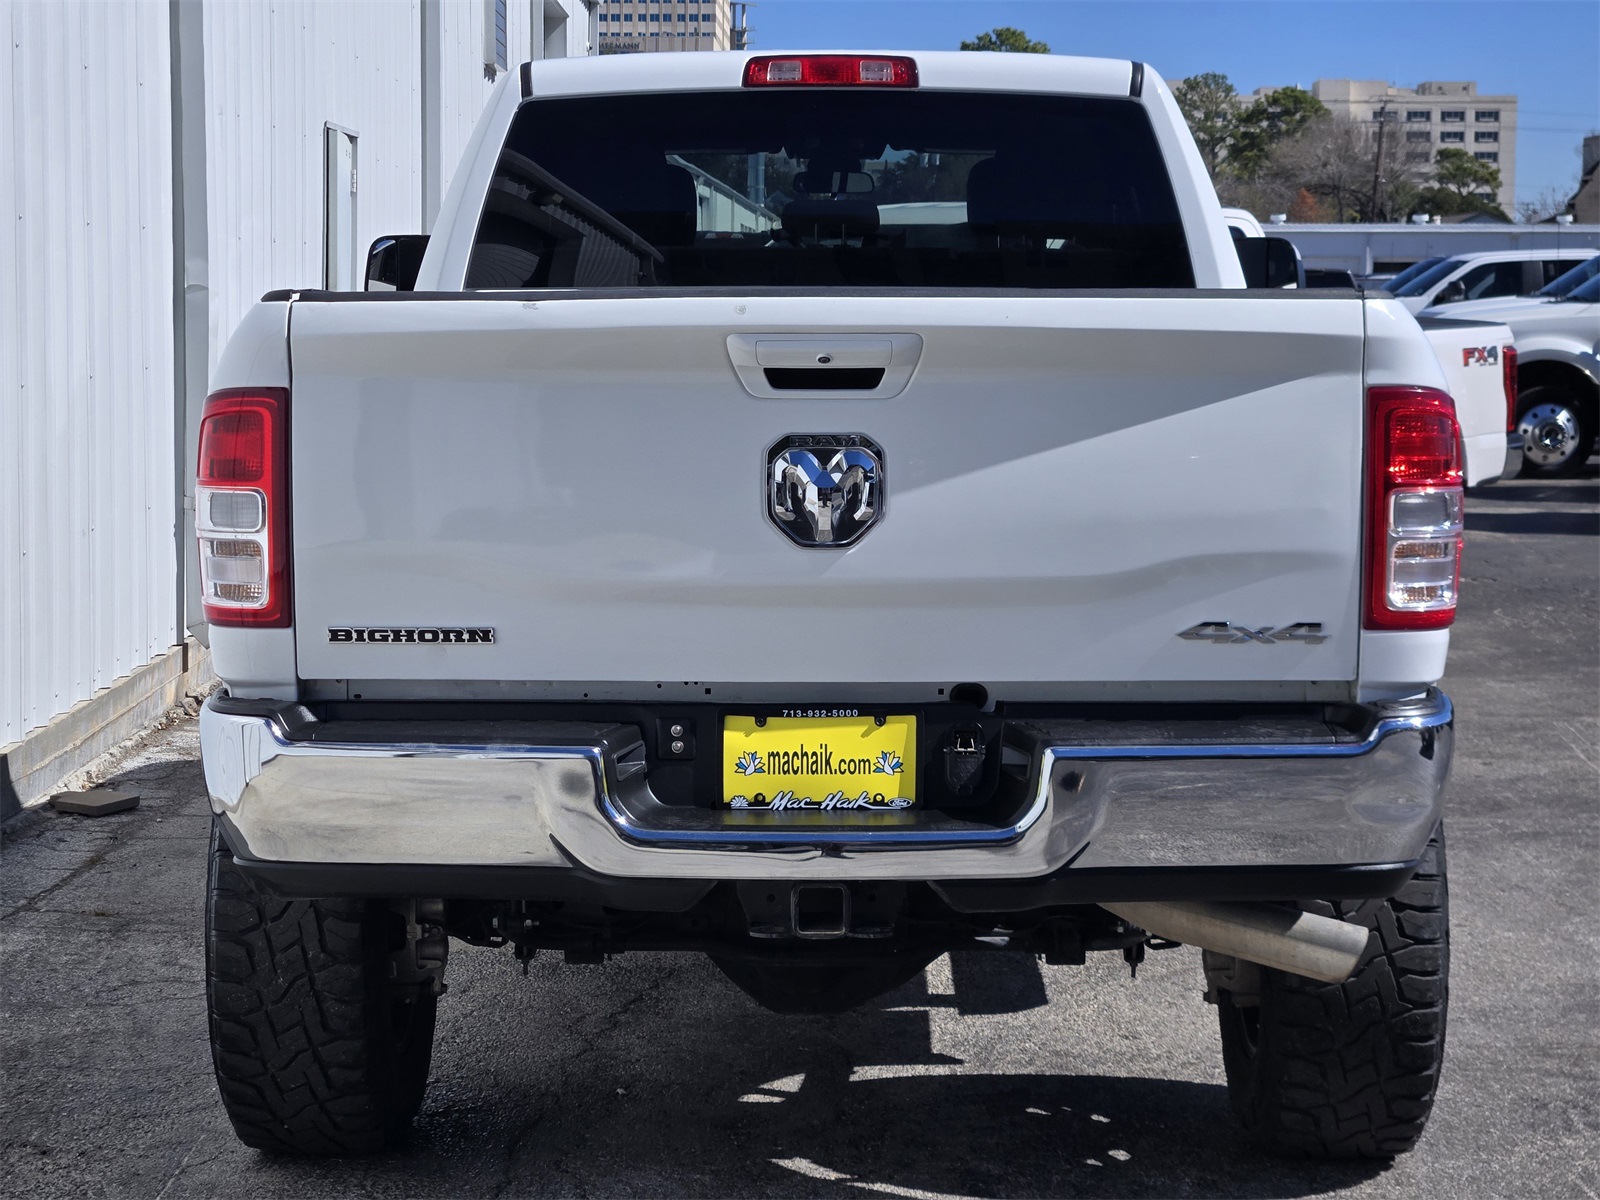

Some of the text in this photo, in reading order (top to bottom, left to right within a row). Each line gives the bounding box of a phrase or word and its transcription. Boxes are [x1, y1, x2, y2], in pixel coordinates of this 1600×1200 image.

[1463, 346, 1498, 367] FX4
[790, 436, 861, 447] RAM
[328, 626, 495, 644] BIGHORN
[782, 709, 859, 718] 713-932-5000
[766, 744, 872, 776] machaik.com
[768, 791, 872, 811] Mac Haik
